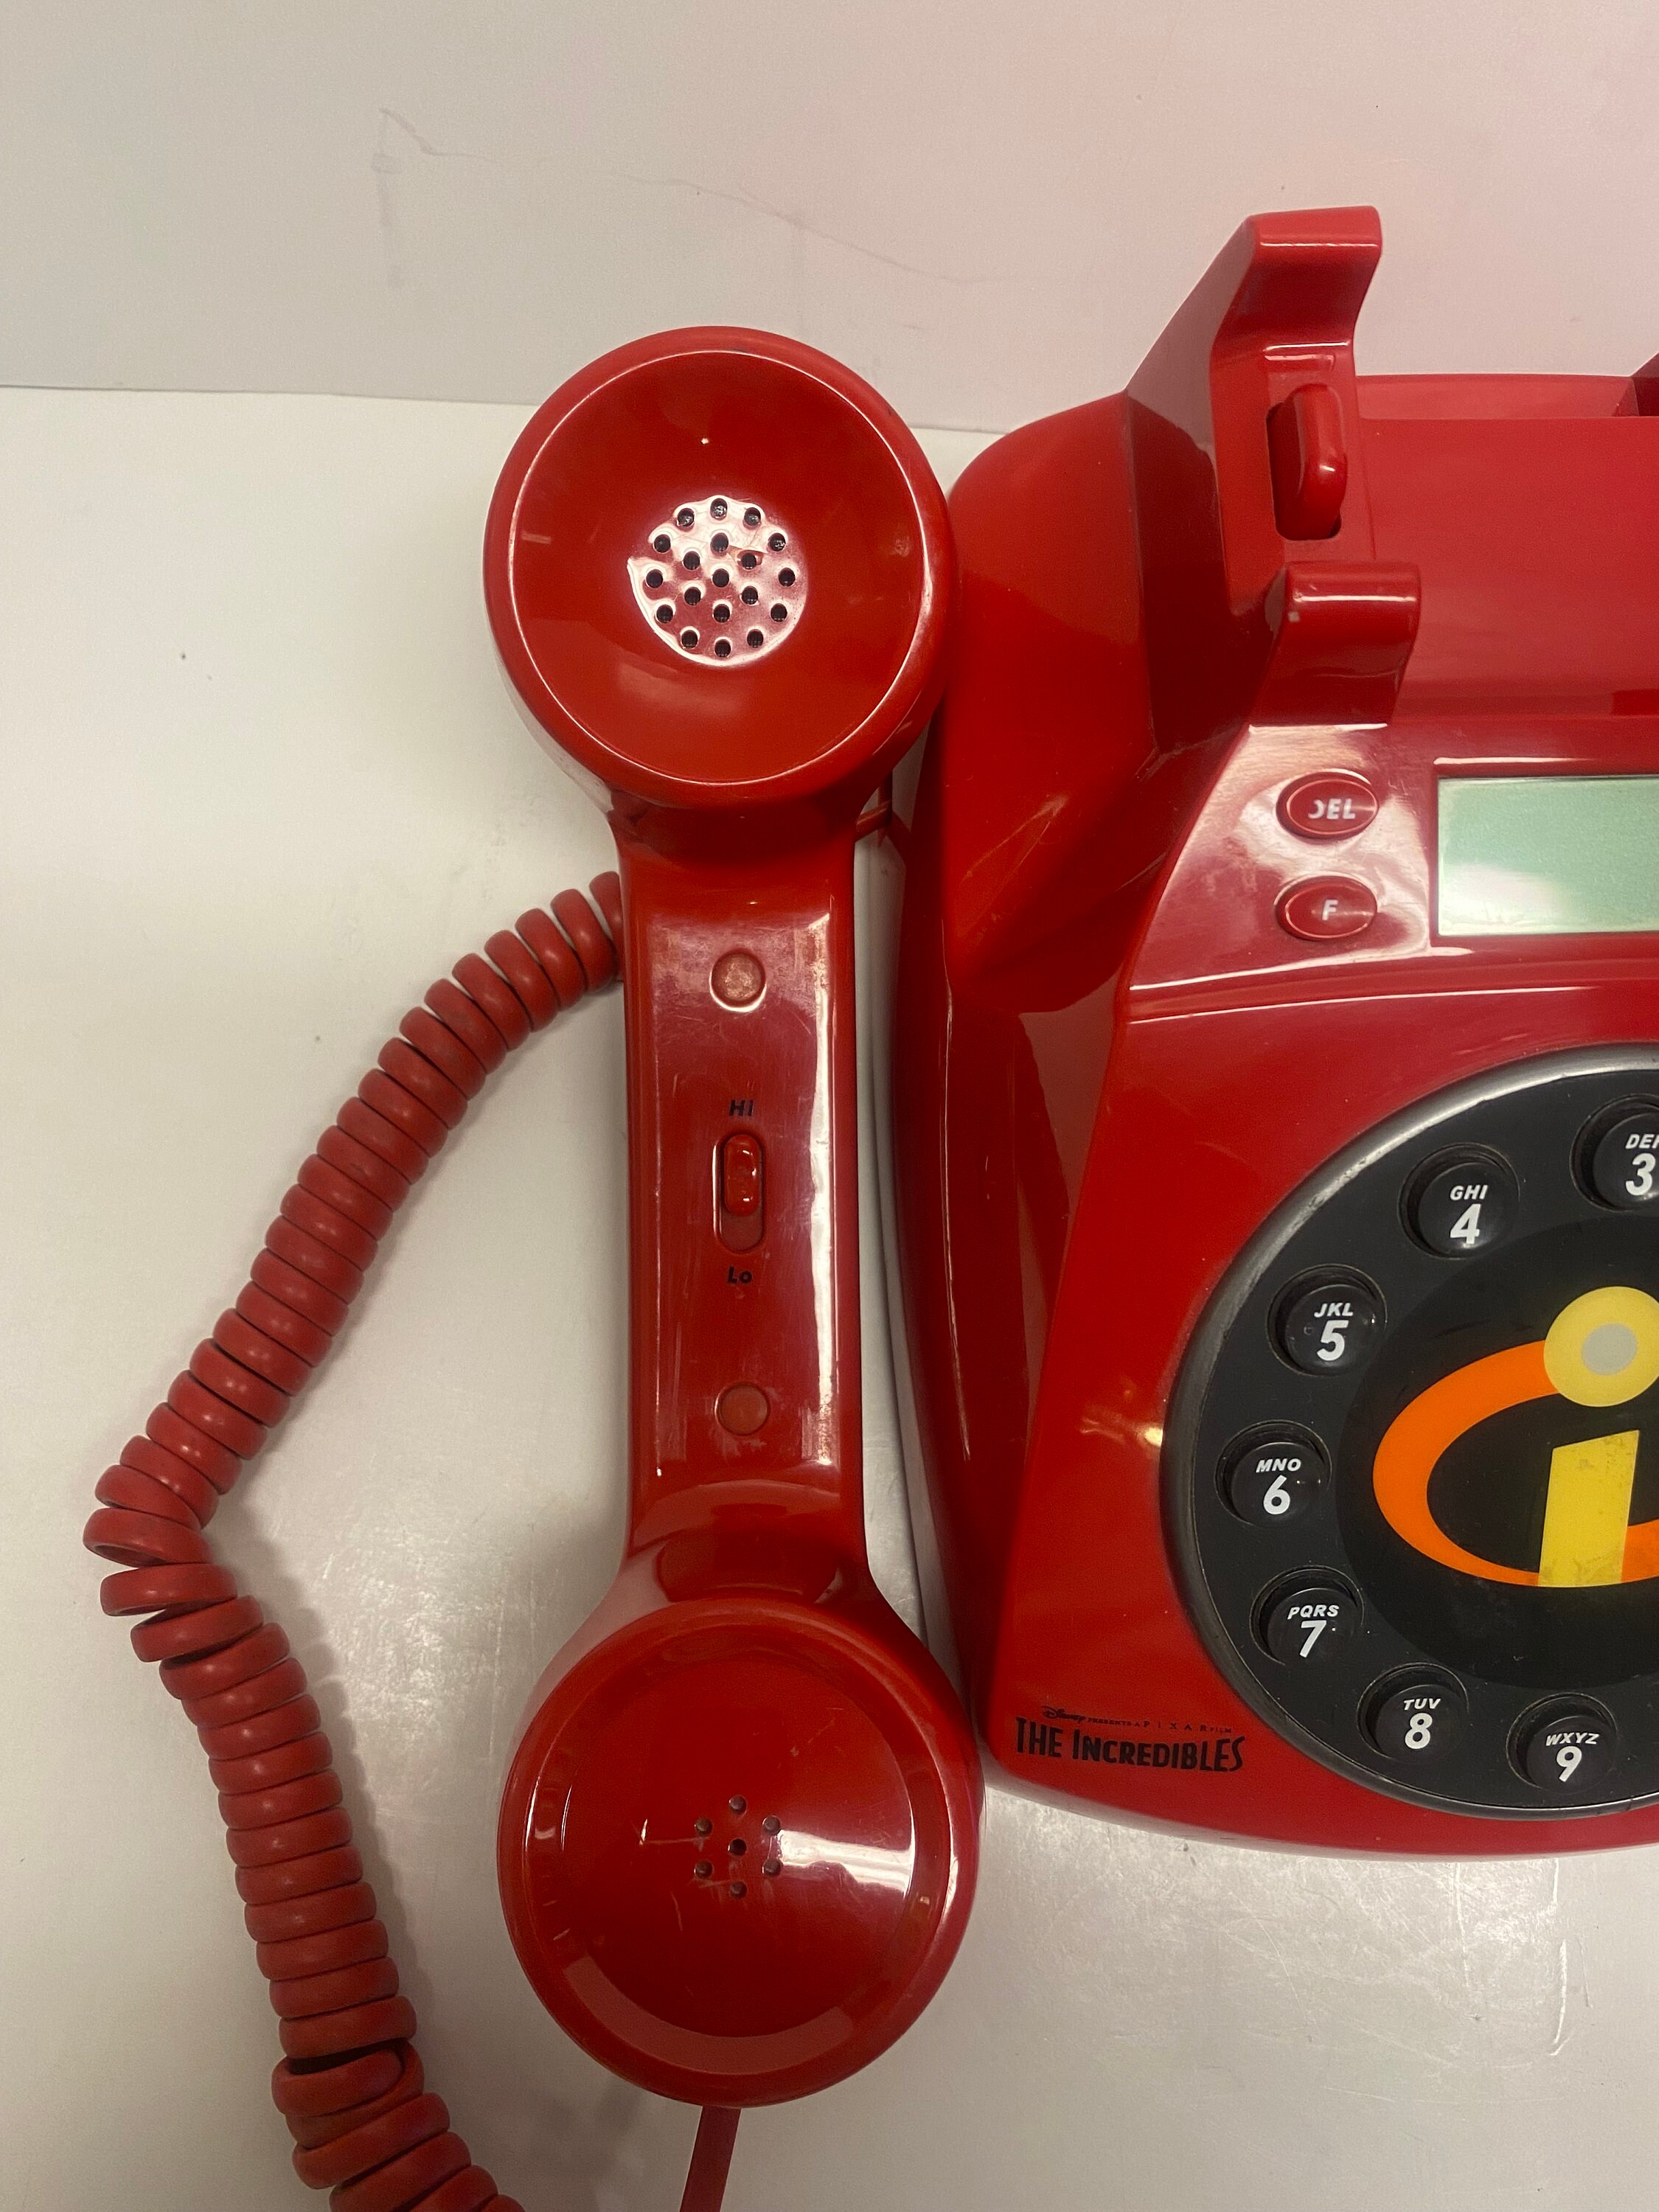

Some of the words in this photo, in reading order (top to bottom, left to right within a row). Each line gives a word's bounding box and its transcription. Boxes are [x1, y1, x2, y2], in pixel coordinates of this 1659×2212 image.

[1322, 900, 1338, 920] F
[1450, 1185, 1489, 1200] GHI
[1625, 1152, 1656, 1196] 3
[1450, 1203, 1481, 1245] 4
[1314, 1302, 1354, 1318] JKL
[1316, 1320, 1349, 1361] 5
[1256, 1458, 1301, 1473] MNO
[1263, 1475, 1291, 1515] 6
[1287, 1604, 1339, 1620] PQRS
[1298, 1621, 1326, 1658] 7
[1403, 1698, 1441, 1711] TUV
[1015, 1716, 1064, 1758] THE
[1405, 1713, 1433, 1750] 8
[1545, 1732, 1600, 1746] WXYZ
[1556, 1745, 1582, 1782] 9
